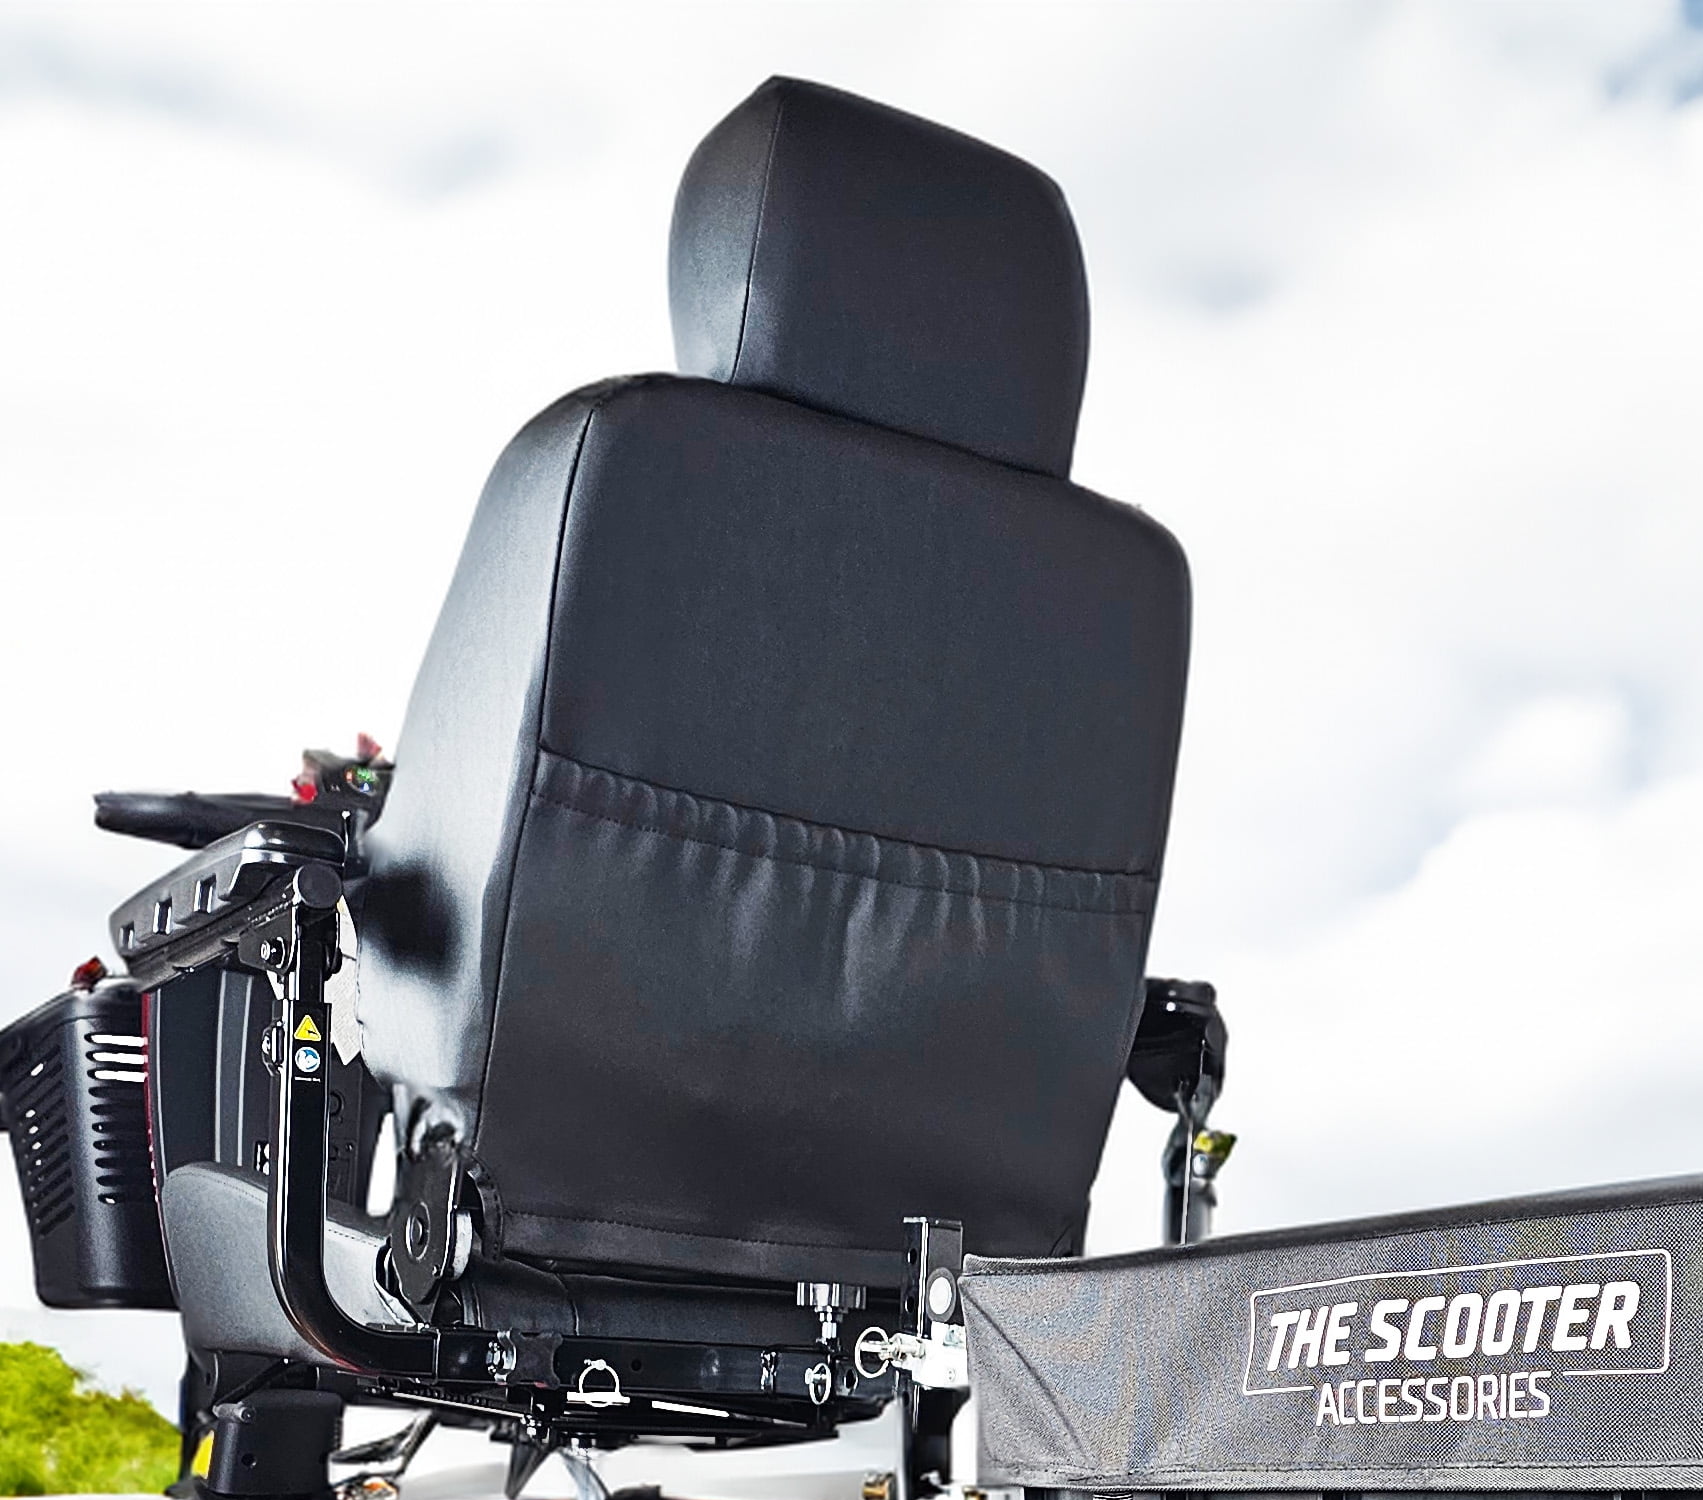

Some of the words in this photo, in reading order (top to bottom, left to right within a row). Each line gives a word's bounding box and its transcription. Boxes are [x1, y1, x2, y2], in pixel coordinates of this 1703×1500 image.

[1266, 1301, 1359, 1372] THE
[1364, 1280, 1642, 1363] SCOOTER
[1315, 1371, 1553, 1427] ACCESSORIES
